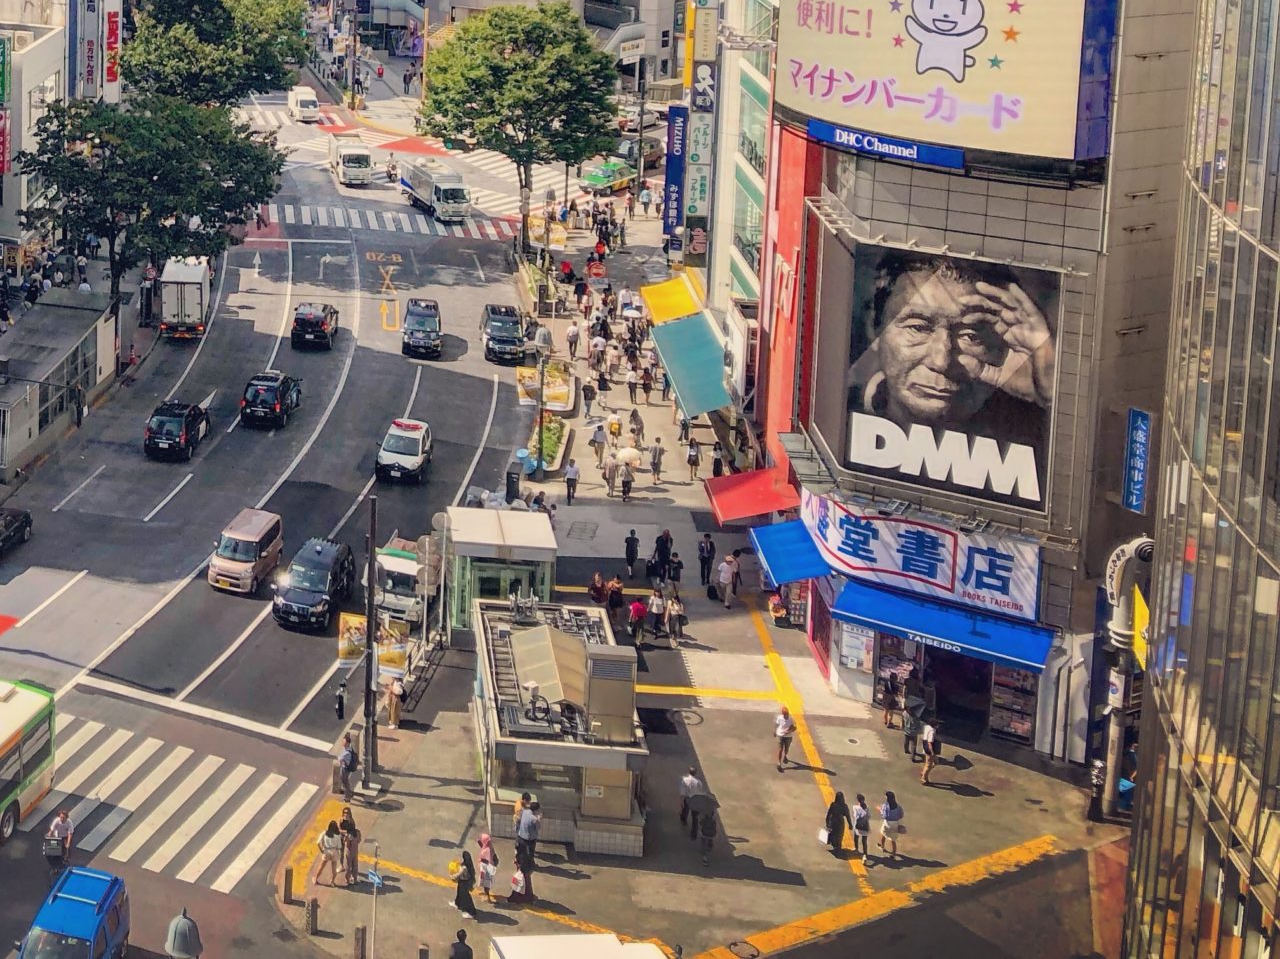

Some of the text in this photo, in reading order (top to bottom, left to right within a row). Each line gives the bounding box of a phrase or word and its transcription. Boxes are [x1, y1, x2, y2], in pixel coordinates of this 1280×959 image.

[789, 58, 1023, 130] マイナンバーカード
[673, 116, 684, 156] MIZUHO
[835, 129, 918, 159] DHC Channel
[850, 412, 1041, 502] DMM
[962, 590, 1024, 612] BOOKS TAISEIDO
[907, 632, 962, 652] TAISEIDO
